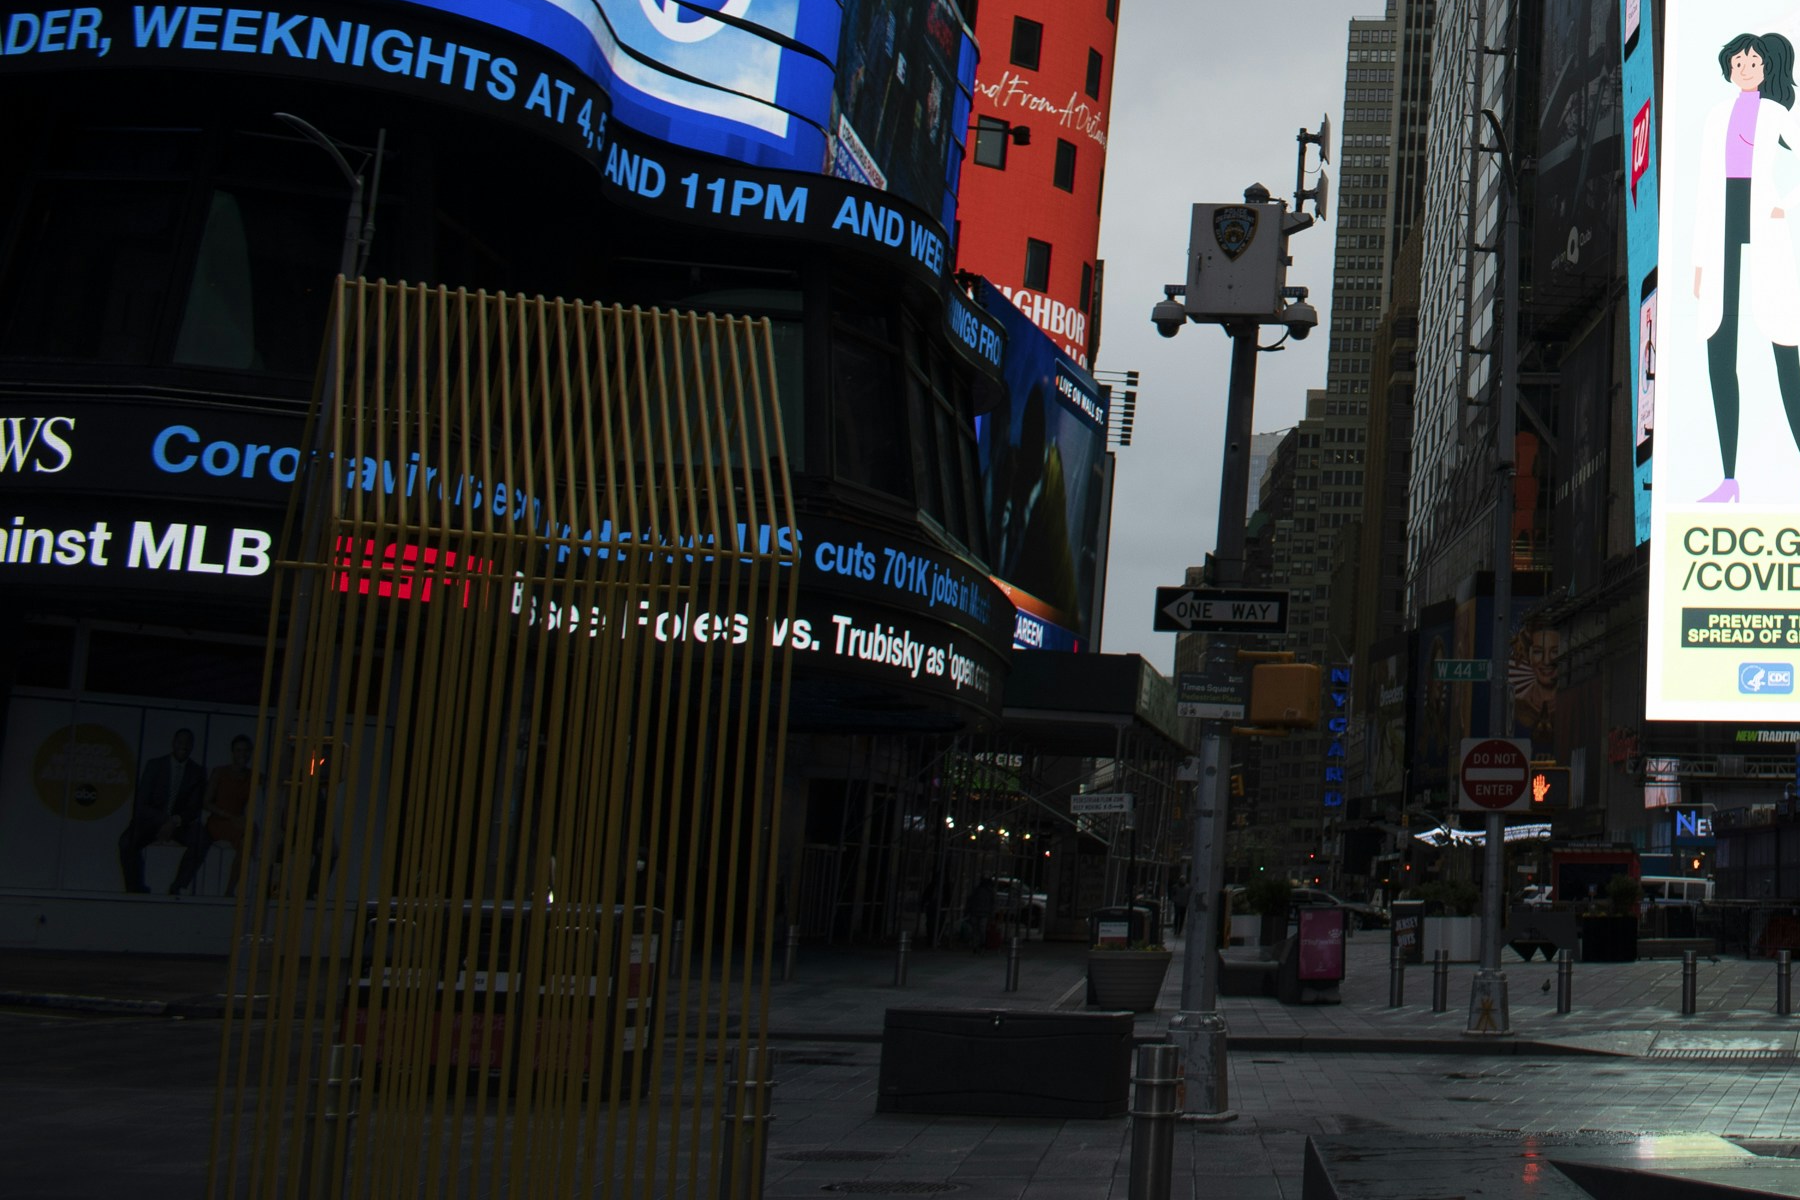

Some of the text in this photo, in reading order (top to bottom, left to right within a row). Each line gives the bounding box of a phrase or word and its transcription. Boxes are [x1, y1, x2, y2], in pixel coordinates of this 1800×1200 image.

[0, 7, 112, 57] DER,
[133, 6, 518, 102] WEEKNIGHTS
[525, 72, 575, 123] AT
[605, 142, 665, 199] AND
[681, 173, 808, 223] 11PM
[832, 196, 904, 247] AND
[1058, 375, 1074, 399] LIVE
[1081, 394, 1096, 418] WALL
[0, 517, 272, 576] inst MLB
[814, 540, 876, 582] cuts
[882, 546, 931, 597] 701K
[929, 562, 958, 608] jobs
[959, 576, 969, 612] in
[1177, 602, 1271, 620] ONE WAY
[1708, 614, 1784, 629] PREVENT
[1688, 629, 1755, 643] SPREAD
[1759, 629, 1781, 643] OF
[832, 613, 924, 678] Trubisky
[926, 645, 945, 677] as
[1437, 663, 1448, 678] W
[1453, 662, 1472, 677] 44
[1769, 672, 1789, 683] CDC
[1182, 683, 1235, 694] Times Square
[1473, 753, 1517, 765] DO NOT
[1475, 784, 1513, 796] ENTER
